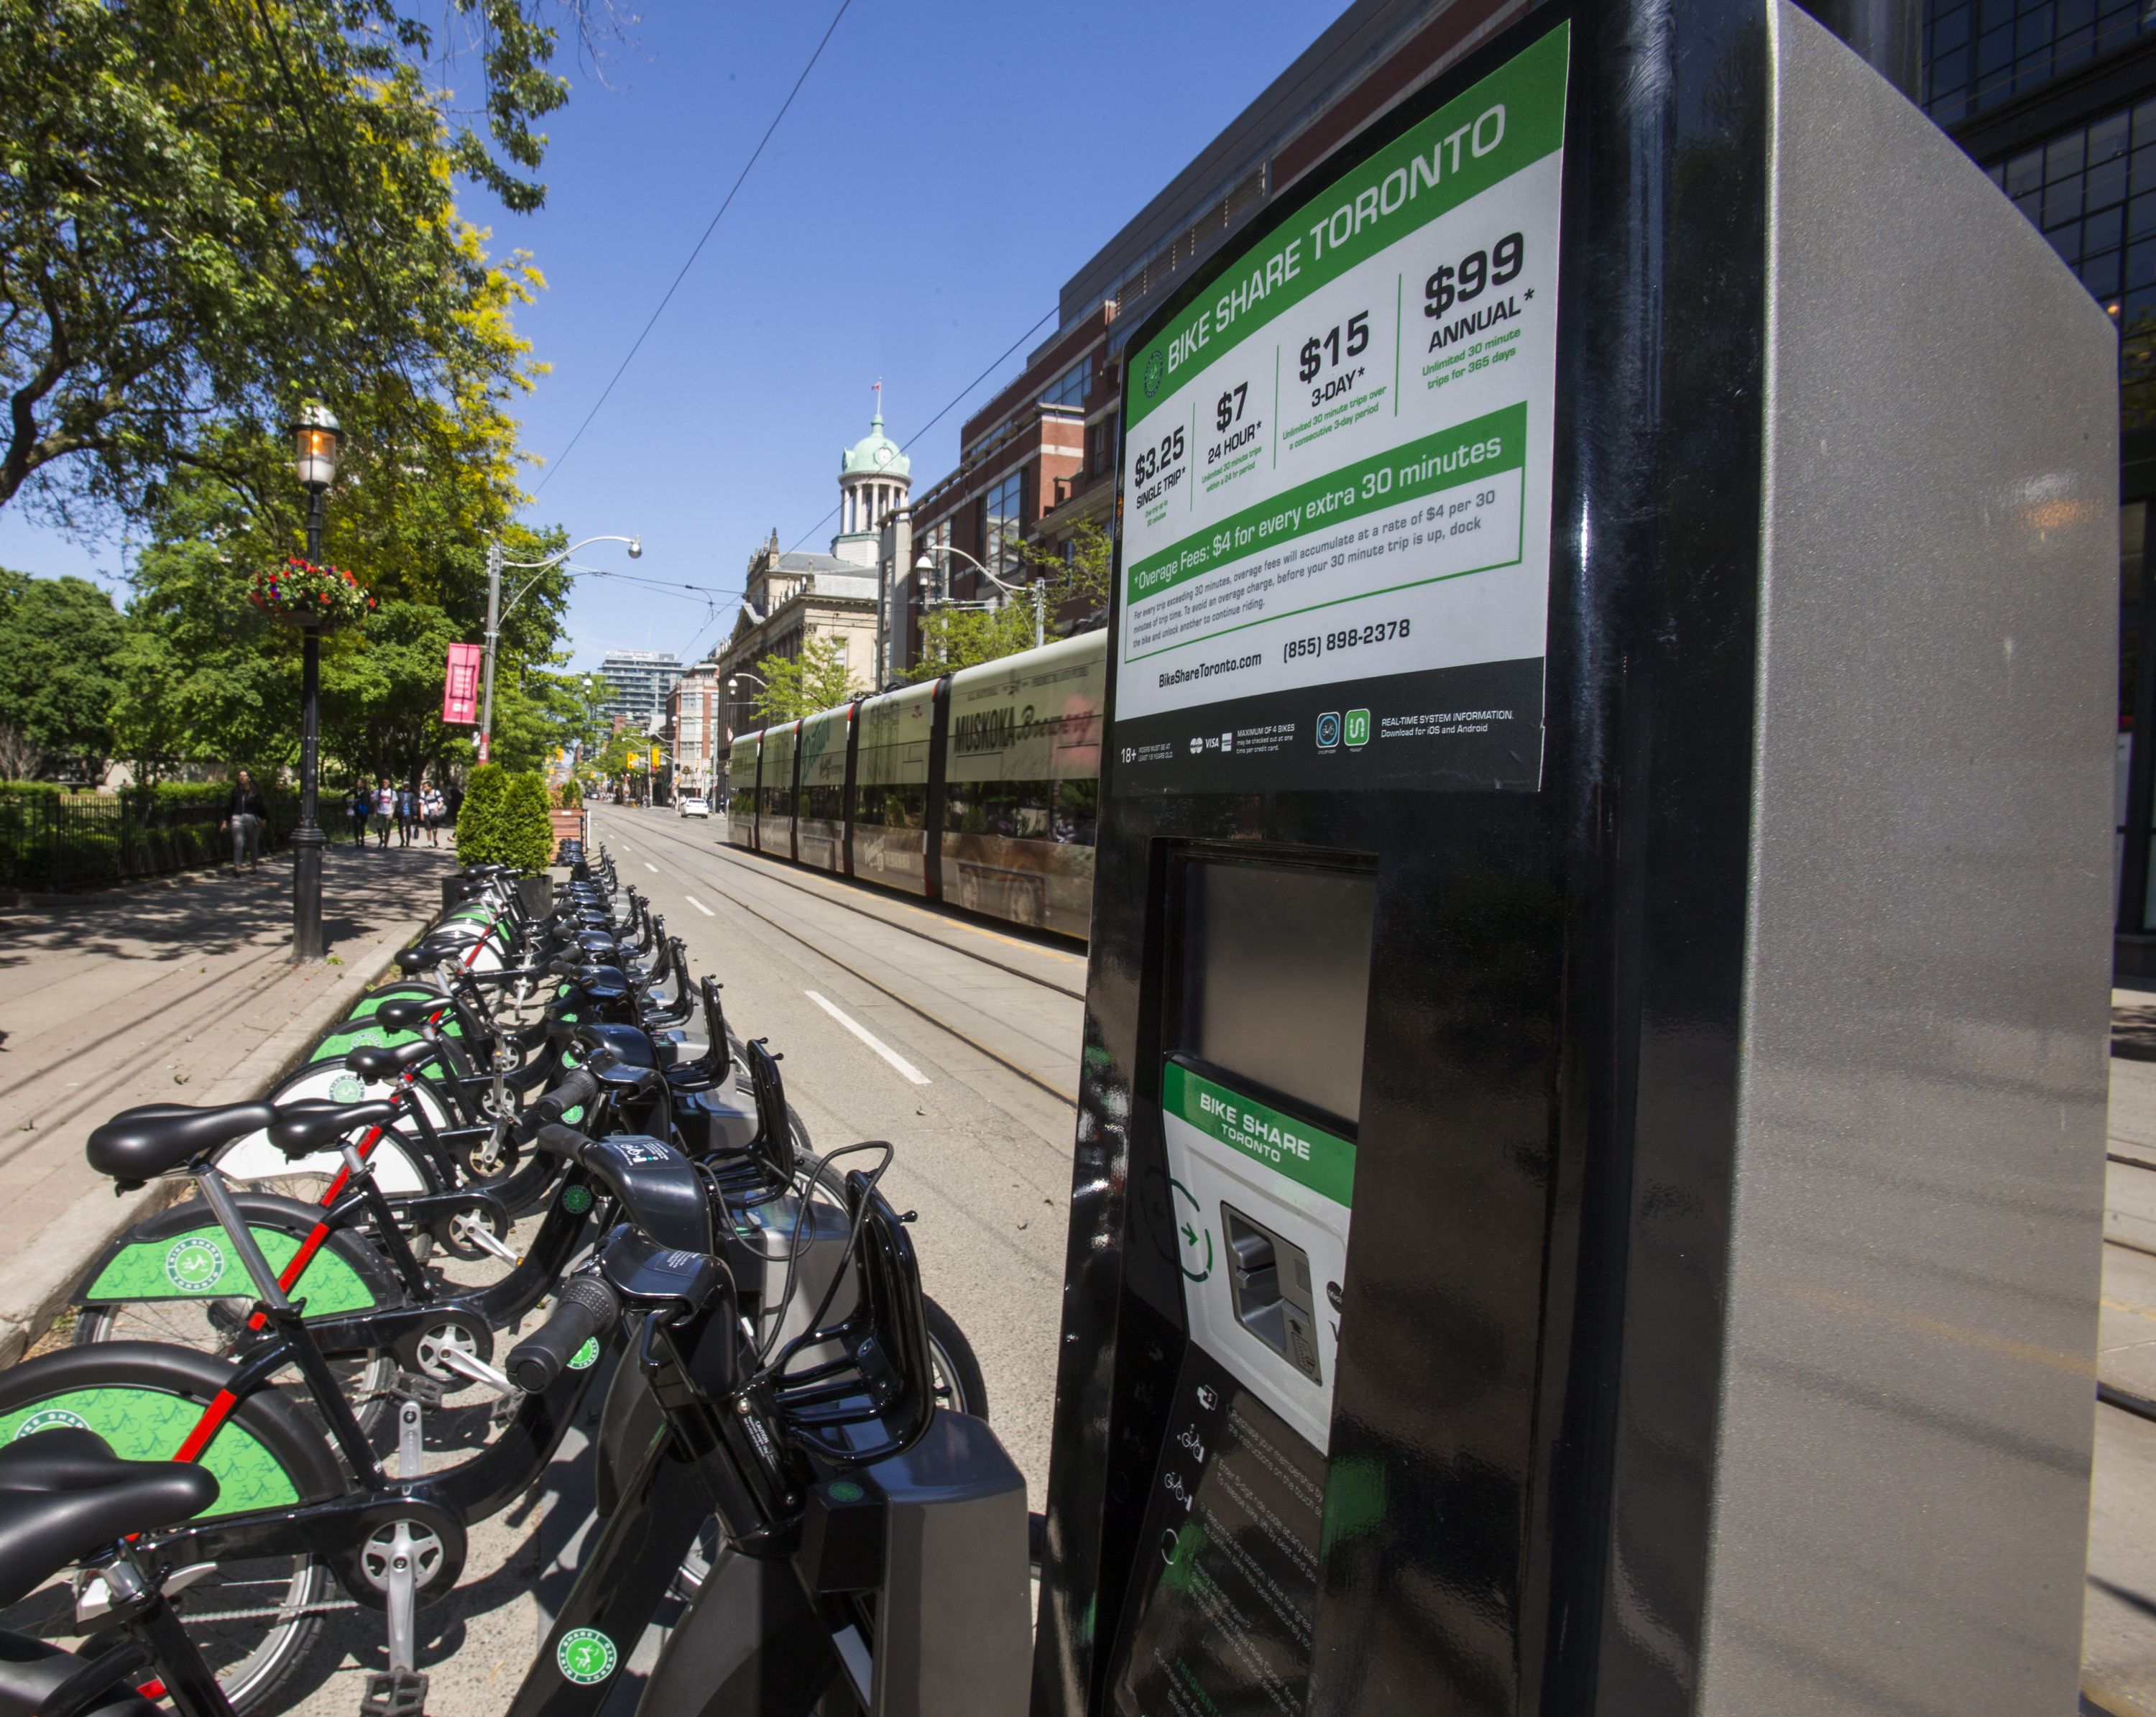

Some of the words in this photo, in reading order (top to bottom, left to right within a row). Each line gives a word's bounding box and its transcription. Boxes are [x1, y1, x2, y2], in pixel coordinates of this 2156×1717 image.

[1168, 310, 1210, 374] BIKE
[1216, 239, 1301, 333] SHARE
[1309, 103, 1506, 260] TORONTO
[1424, 231, 1524, 320] $99
[1299, 310, 1369, 384] $15
[1422, 349, 1465, 376] Unlimited
[1468, 343, 1482, 357] 30
[1485, 328, 1521, 351] minute
[1427, 375, 1450, 390] trips
[1452, 367, 1465, 380] for
[1468, 356, 1489, 374] 365
[1493, 347, 1516, 364] days
[1217, 381, 1248, 433] $7
[1283, 418, 1312, 440] Unlimited
[1313, 414, 1322, 425] 30
[1324, 403, 1348, 420] minute
[1350, 392, 1367, 408] trips
[1369, 386, 1387, 400] over
[1294, 426, 1332, 448] consecutive
[1334, 416, 1353, 431] 3-day
[1355, 402, 1379, 425] period
[1135, 425, 1184, 489] $3.25
[1208, 443, 1221, 464] 24
[1137, 482, 1162, 510] SINGLE
[1180, 546, 1210, 571] Fees:
[1212, 530, 1231, 558] $4
[1235, 525, 1256, 547] for
[1258, 505, 1302, 538] every
[1306, 487, 1355, 519] extra
[1362, 467, 1391, 499] 30
[1400, 436, 1501, 487] minutes
[1167, 590, 1193, 607] exceeding
[1195, 584, 1204, 597] 30
[1204, 575, 1232, 593] minutes,
[1234, 565, 1262, 582] overage
[1264, 557, 1281, 571] fees
[1284, 549, 1297, 565] will
[1299, 532, 1354, 558] accumulate
[1358, 528, 1369, 540] at
[1372, 527, 1378, 536] a
[1382, 519, 1407, 534] rate
[1411, 511, 1423, 525] of
[1427, 505, 1445, 521] $4
[1449, 500, 1471, 516] per
[1476, 489, 1496, 507] 30
[1192, 600, 1207, 613] avoid
[1209, 597, 1217, 607] an
[1218, 587, 1245, 604] overage
[1247, 576, 1275, 594] charge,
[1277, 566, 1304, 585] before
[1307, 561, 1328, 579] your
[1330, 553, 1345, 568] 30
[1348, 544, 1384, 563] minute
[1388, 535, 1409, 553] trip
[1413, 533, 1423, 546] is
[1427, 529, 1445, 543] up,
[1450, 517, 1481, 536] dock
[1162, 625, 1179, 638] unlock
[1180, 617, 1202, 631] another
[1204, 614, 1211, 623] to
[1212, 604, 1240, 622] continue
[1242, 598, 1266, 612] riding.
[1284, 635, 1322, 664] (855)
[1326, 619, 1411, 653] 898-2378
[1158, 653, 1262, 689] BikeShareToronto.com
[954, 706, 1015, 753] MUSKOKA
[1237, 727, 1263, 737] MAXIMUM
[1278, 723, 1295, 732] BIKES
[1381, 716, 1418, 727] REAL-TIME
[1419, 713, 1452, 724] SYSTEM
[1381, 727, 1414, 738] Download
[1414, 727, 1426, 735] for
[1427, 725, 1439, 735] iOS
[1441, 724, 1455, 734] and
[1456, 723, 1488, 734] Android
[1121, 747, 1136, 763] 18+
[1205, 737, 1220, 748] VISA
[1200, 1092, 1236, 1125] BIKE
[1243, 1113, 1310, 1161] SHARE
[1222, 1123, 1281, 1163] TORONTO
[173, 1271, 218, 1289] TORONTO
[1273, 1450, 1314, 1493] membership
[586, 1642, 614, 1682] TORONTO
